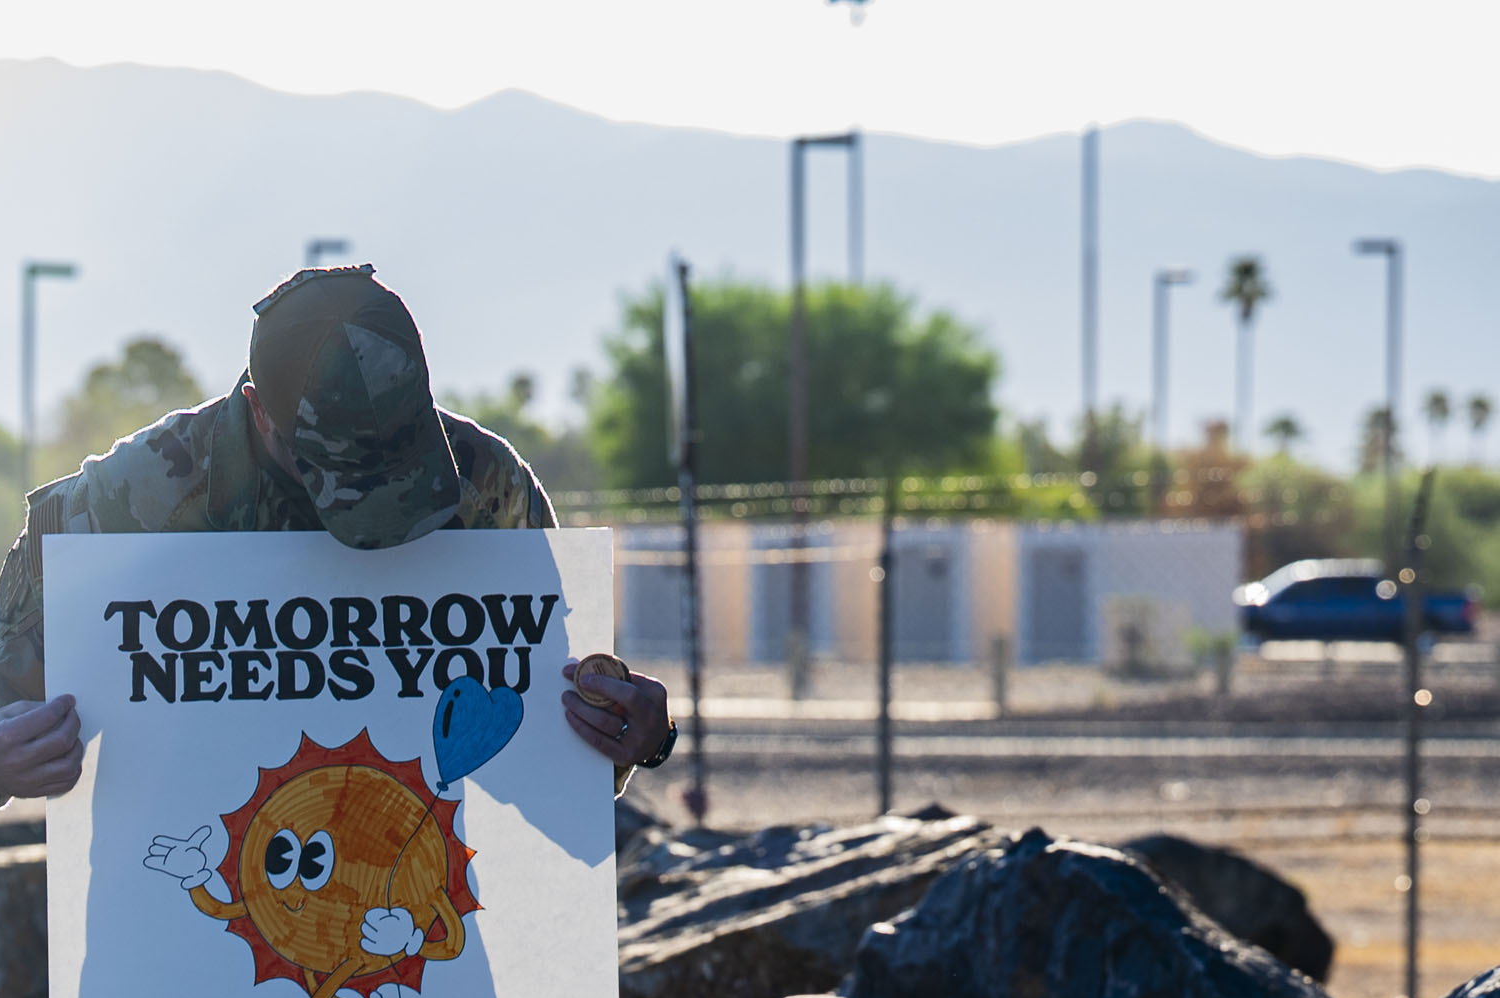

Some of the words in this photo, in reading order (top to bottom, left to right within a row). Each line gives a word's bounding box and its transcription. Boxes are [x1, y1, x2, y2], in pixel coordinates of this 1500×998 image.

[104, 593, 559, 652] TOMORROW
[129, 648, 375, 704] NEEDS
[385, 646, 531, 698] YOU
